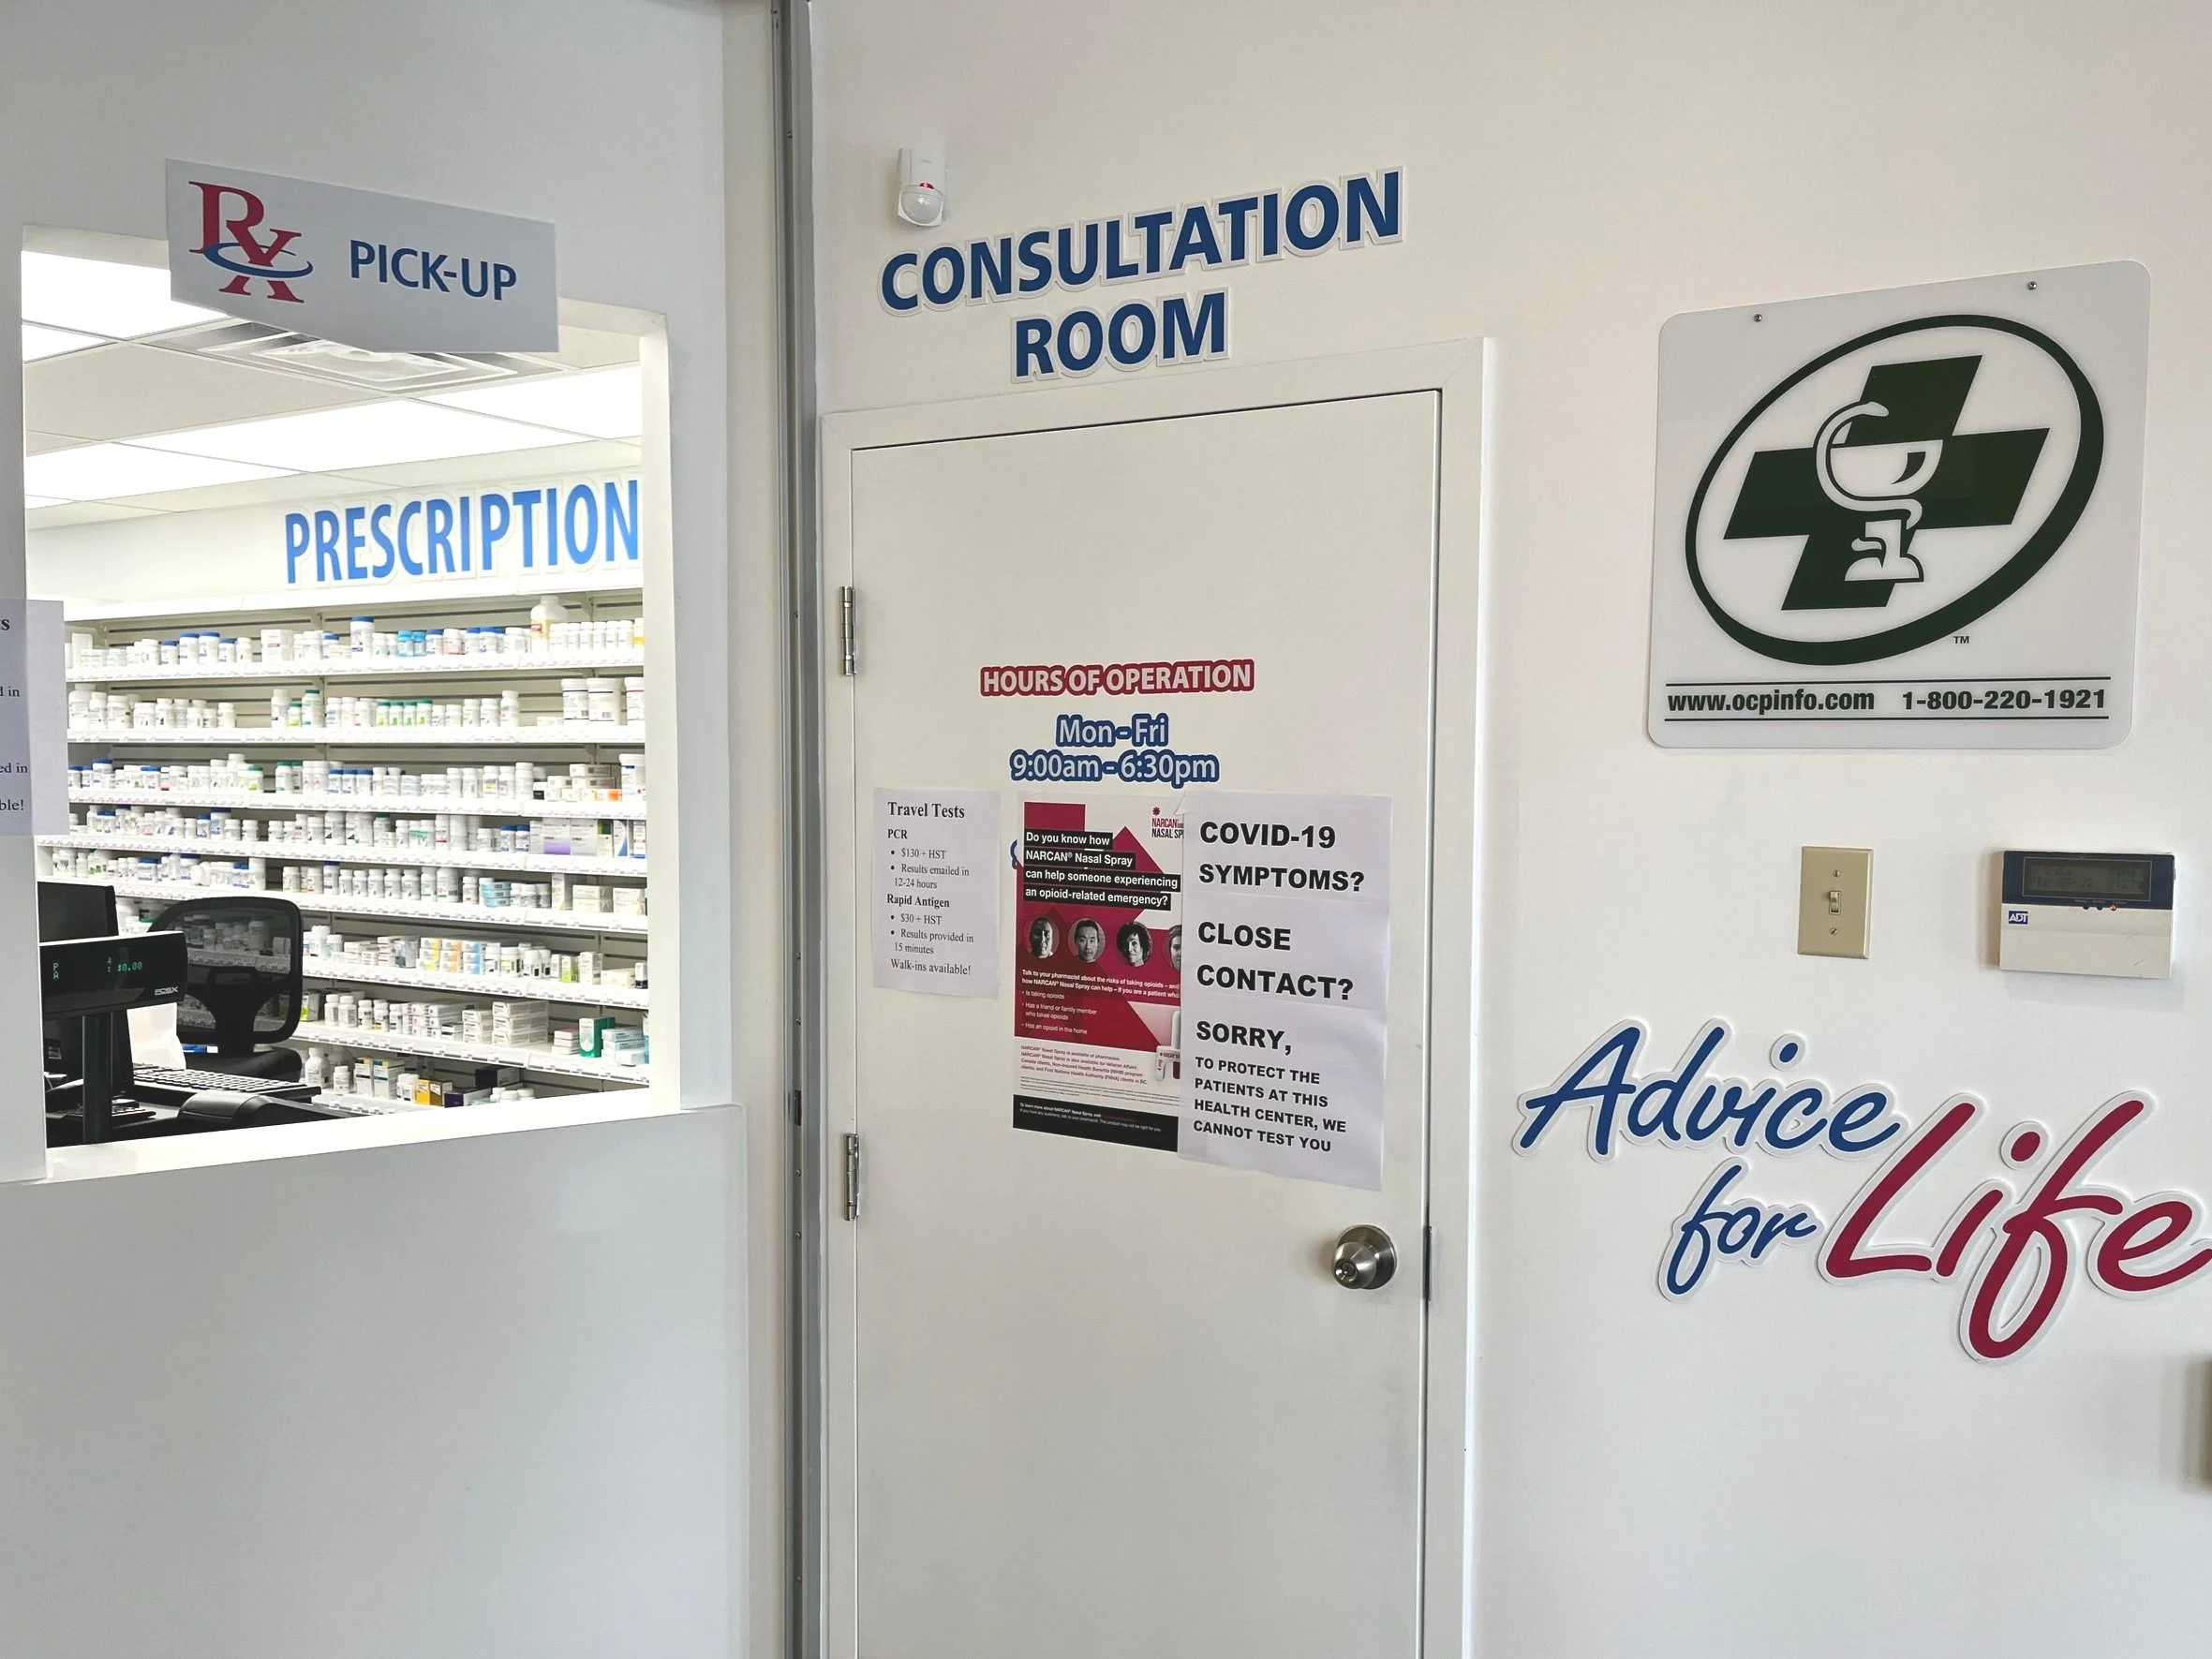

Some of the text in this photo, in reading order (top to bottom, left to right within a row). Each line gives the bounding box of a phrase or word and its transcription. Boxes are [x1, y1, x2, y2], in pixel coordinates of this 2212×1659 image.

[881, 170, 1400, 311] CONSULTATION
[349, 240, 518, 301] PICK-UP
[1016, 291, 1225, 377] ROOM
[284, 479, 639, 584] PRESCRIPTION
[983, 663, 1252, 693] HOURS OF OPERATION
[1668, 689, 2106, 715] www.ocpinfo.com 1-800-220-1921
[1058, 718, 1113, 743] Mon
[1135, 718, 1165, 744] Fri
[1013, 753, 1099, 778] 9:00am
[1121, 753, 1216, 785] 6:30pm
[887, 802, 965, 819] Travel Tests
[887, 829, 908, 839] PCR
[1026, 832, 1110, 846] Do you know how
[1151, 828, 1173, 838] NASAL
[1199, 822, 1336, 849] COVID-19
[901, 848, 919, 858] $130
[928, 850, 946, 859] HST
[1075, 853, 1102, 864] Nasal
[1104, 855, 1134, 867] Spray
[894, 878, 937, 889] 12-24 hours
[901, 864, 970, 877] Results emailed in
[1025, 869, 1179, 889] can help someone experiencing
[1199, 864, 1365, 892] SYMPTOMS?
[886, 894, 950, 910] Rapid Antigen
[1025, 888, 1168, 908] an opioid-related emergency?
[900, 913, 914, 924] $30
[924, 915, 942, 925] HST
[2009, 911, 2028, 924] ADT
[894, 942, 934, 955] 15 minutes
[900, 928, 973, 943] Results provided in
[1198, 922, 1291, 951] CLOSE
[891, 958, 972, 975] Walk-ins available!
[1075, 983, 1091, 991] Spray
[1126, 979, 1143, 987] taking
[1196, 964, 1354, 1001] CONTACT?
[1196, 1021, 1292, 1056] SORRY,
[1195, 1057, 1320, 1085] TO PROTECT THE
[1195, 1077, 1265, 1099] PATIENTS
[1269, 1089, 1288, 1103] AT
[1292, 1091, 1329, 1107] THIS
[1519, 1026, 1901, 1156] Advice
[1194, 1099, 1346, 1133] HEALTH CENTER, WE
[1194, 1120, 1331, 1152] CANNOT TEST YOU
[1666, 1100, 2212, 1359] for Life
